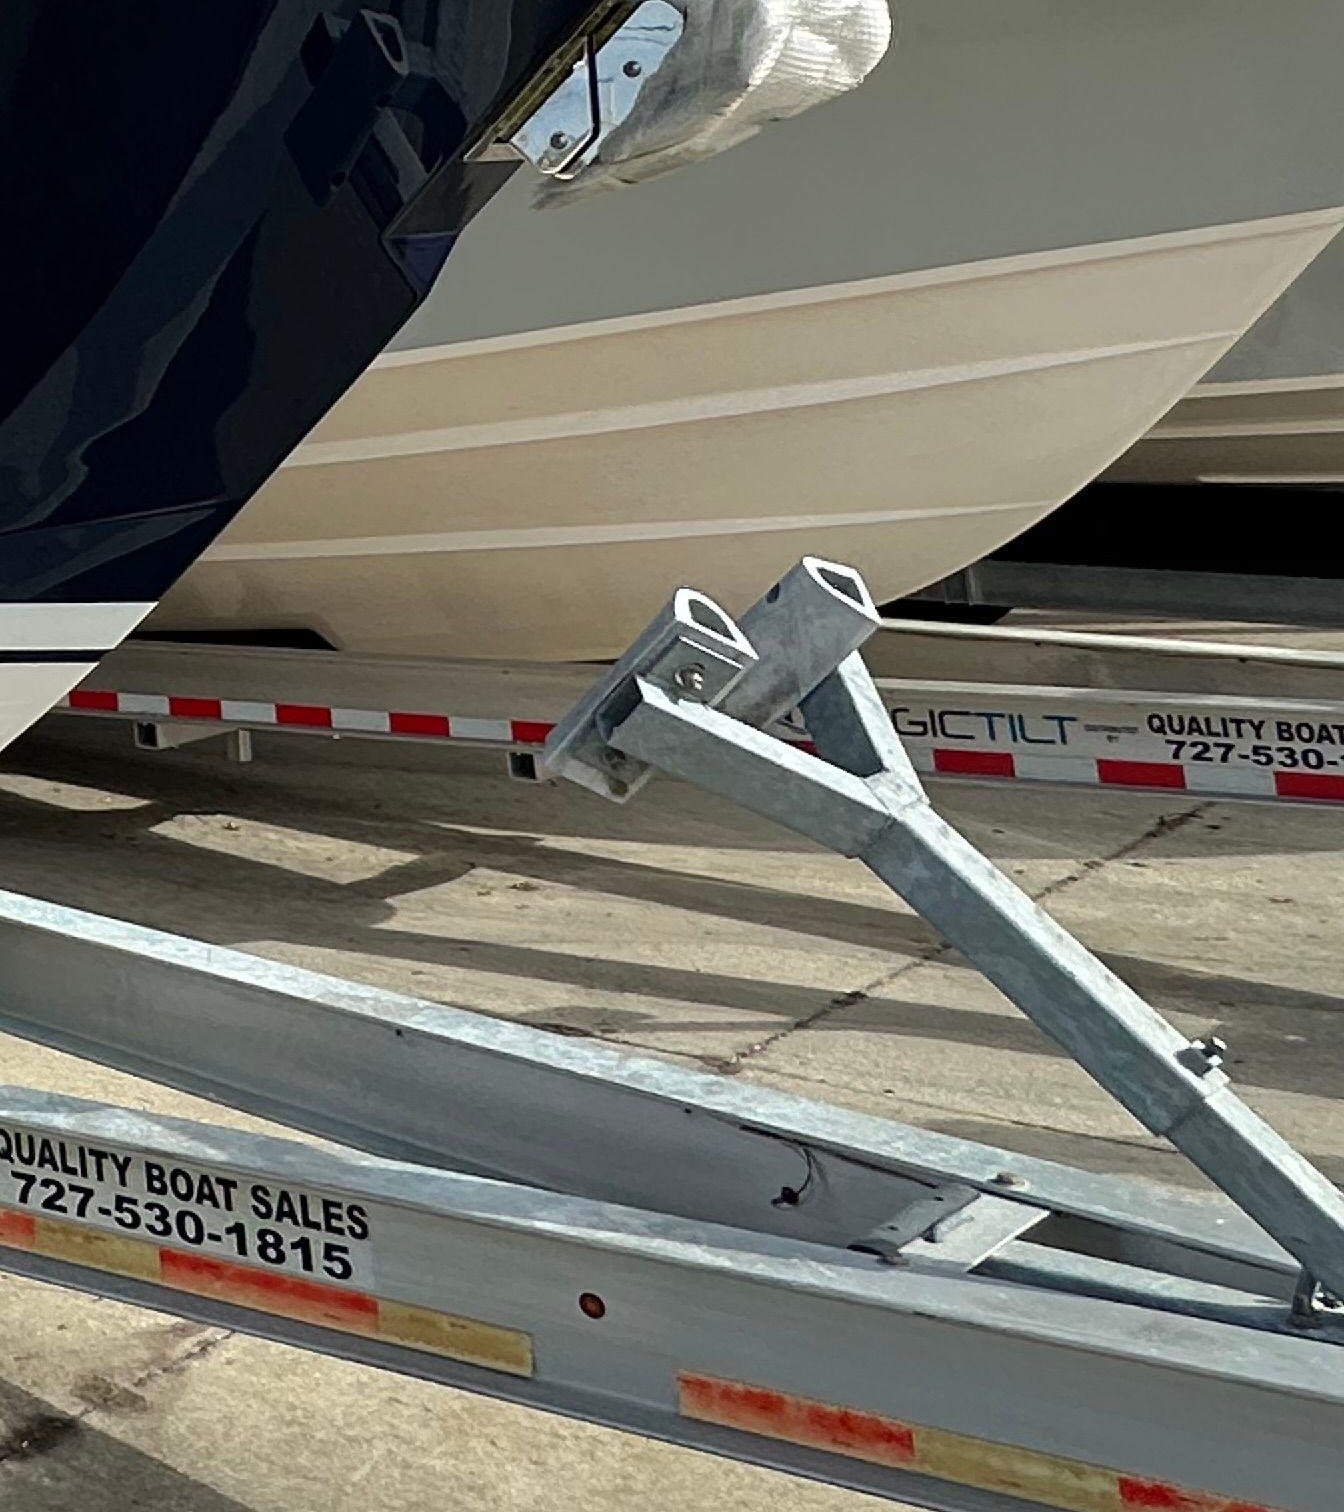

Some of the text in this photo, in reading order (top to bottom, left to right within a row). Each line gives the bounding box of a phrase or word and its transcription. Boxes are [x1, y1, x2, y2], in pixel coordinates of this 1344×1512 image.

[1147, 712, 1266, 741] QUALITY
[10, 1170, 353, 1280] 727-530-1815
[144, 1160, 237, 1212] BOAT
[251, 1185, 369, 1240] SALES
